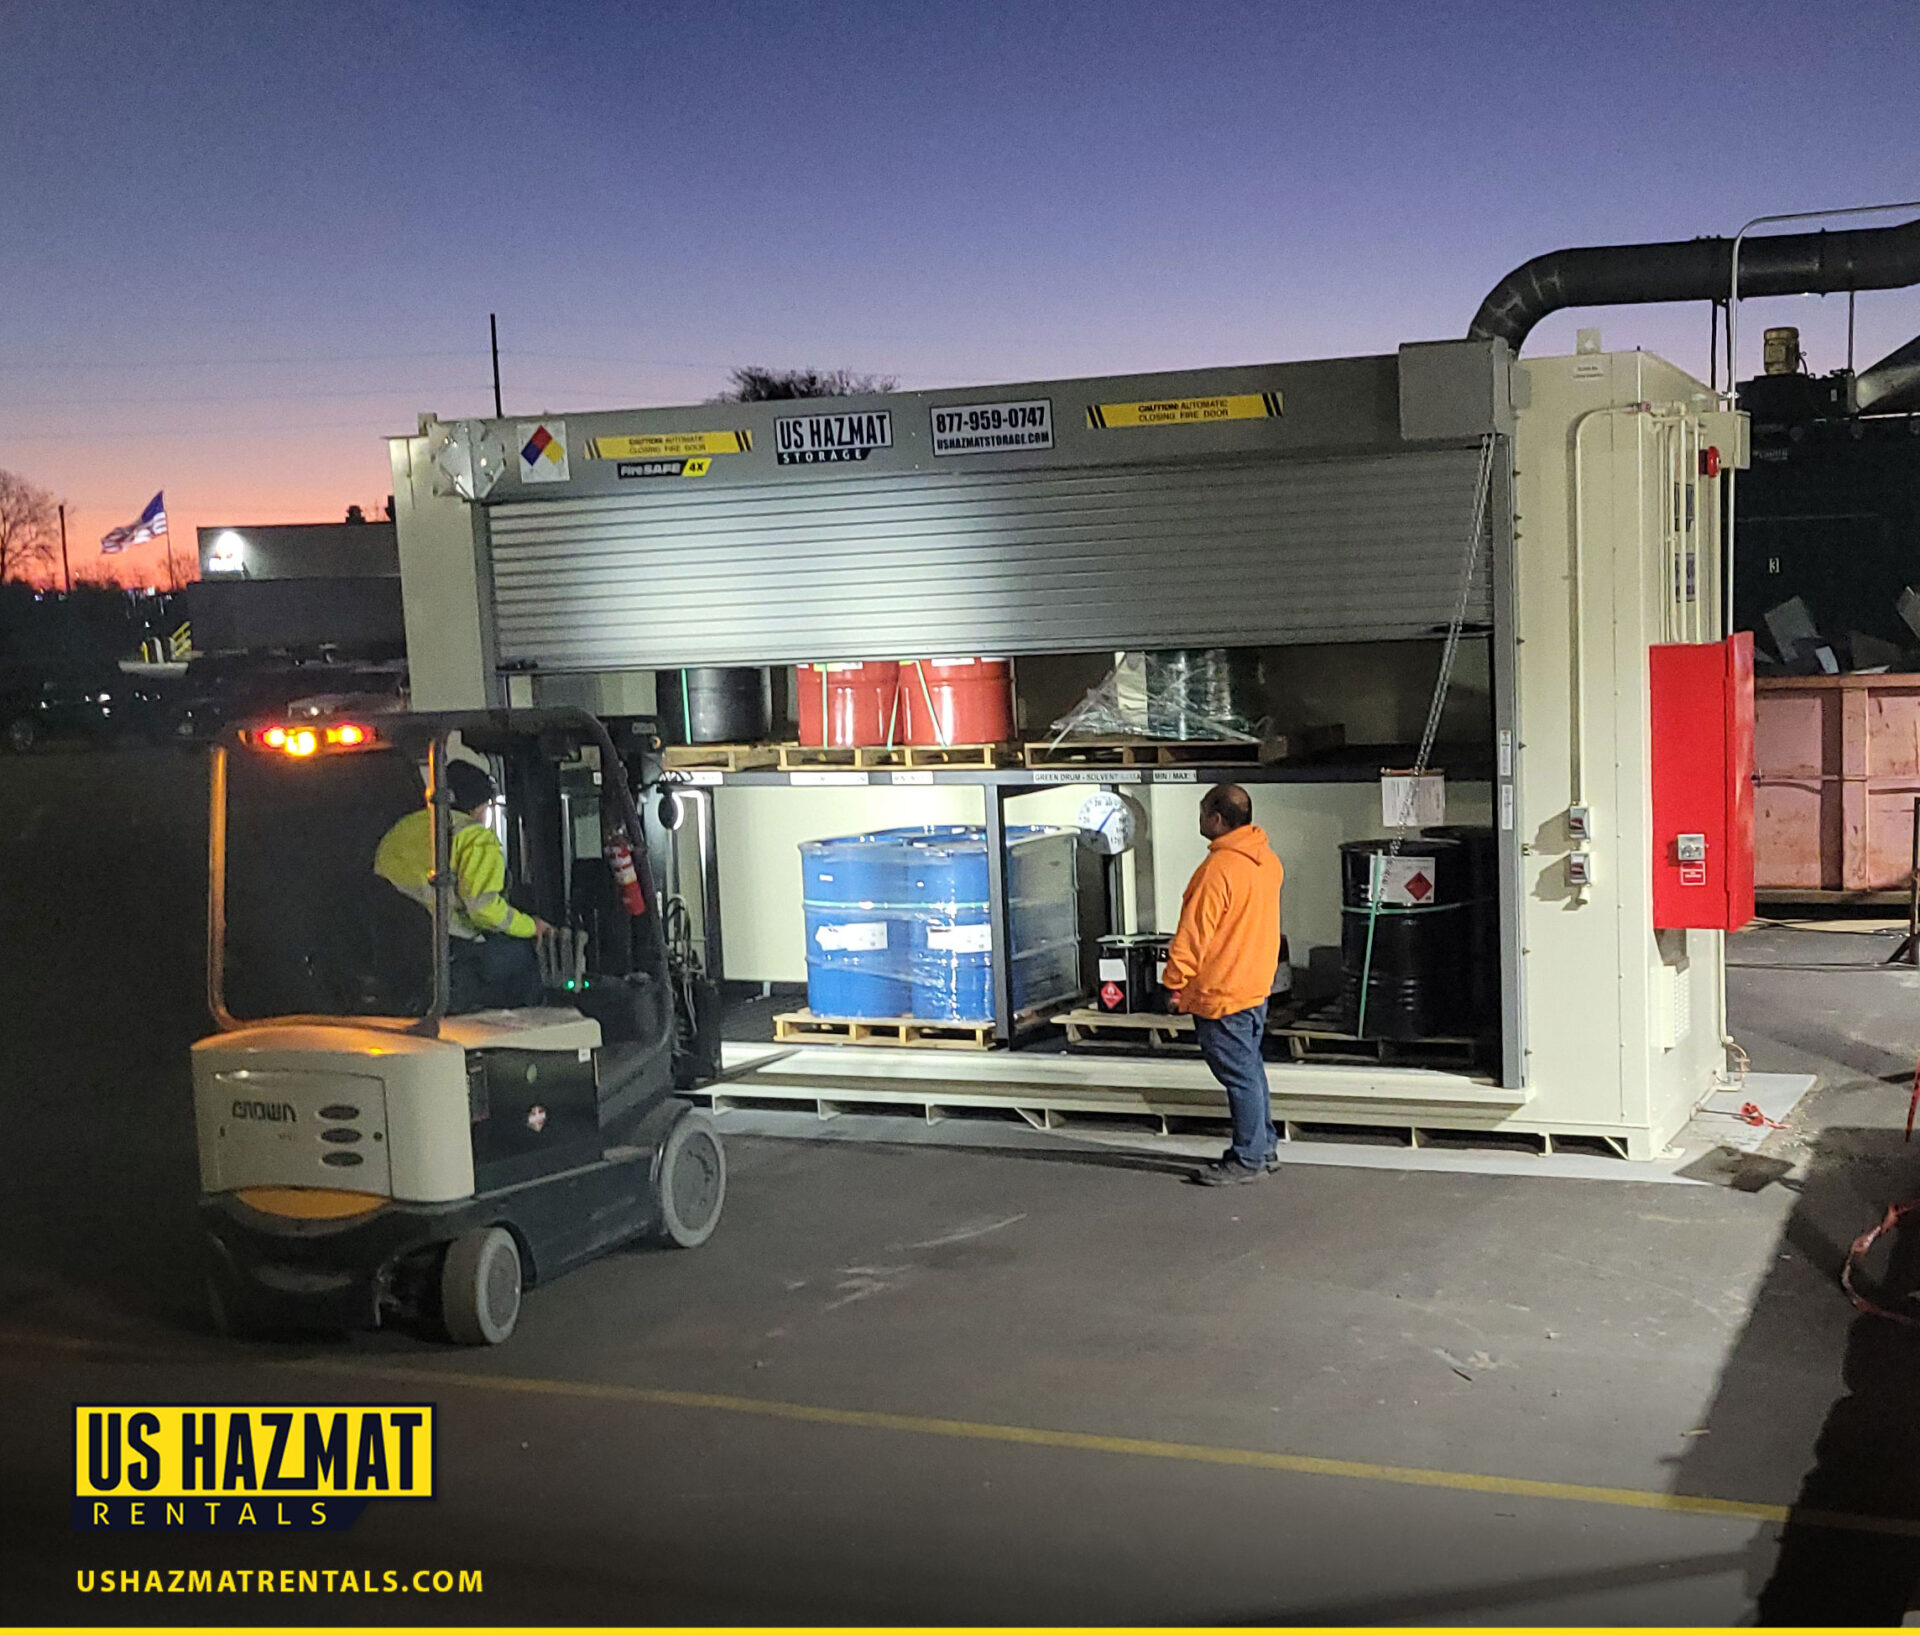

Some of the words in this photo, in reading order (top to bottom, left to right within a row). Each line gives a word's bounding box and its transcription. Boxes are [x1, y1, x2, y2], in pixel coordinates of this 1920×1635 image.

[1181, 400, 1228, 410] AUTOMATIC
[936, 406, 1045, 433] 877-959-0747
[1138, 413, 1176, 422] CLOSING
[1180, 410, 1199, 419] FIRE
[1203, 409, 1229, 418] DOOR
[780, 420, 804, 450] US
[809, 414, 887, 448] HAZMAT
[936, 431, 1050, 450] USHAZMATSTORAGE.COM
[783, 449, 862, 465] STORAGE
[689, 462, 704, 473] 4X
[1035, 773, 1059, 781] GREEN
[1060, 773, 1081, 781] DRUM
[1086, 773, 1118, 781] SOLVENT
[1154, 772, 1167, 780] MIN
